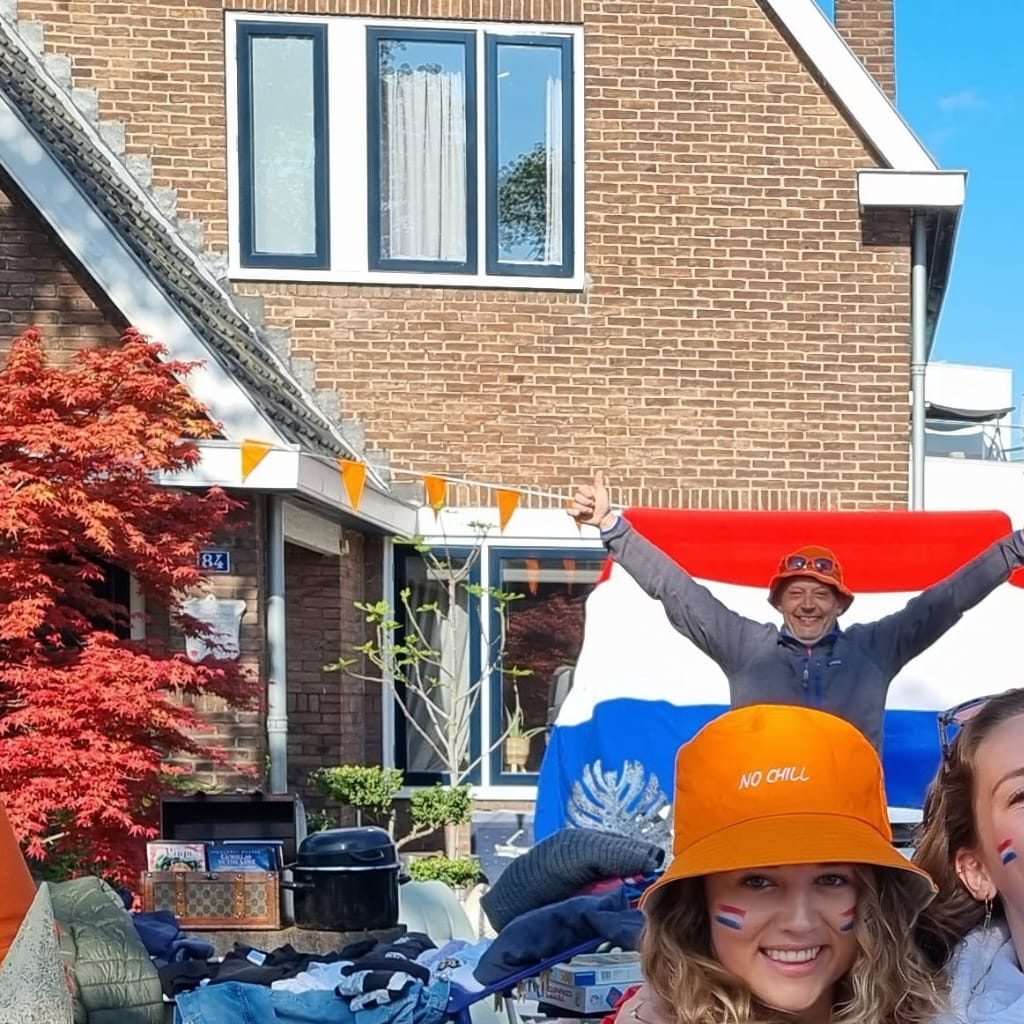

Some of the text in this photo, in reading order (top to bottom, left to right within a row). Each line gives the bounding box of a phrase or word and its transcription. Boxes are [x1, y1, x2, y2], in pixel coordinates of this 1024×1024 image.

[202, 552, 225, 570] 84
[738, 765, 811, 791] NO CHILL
